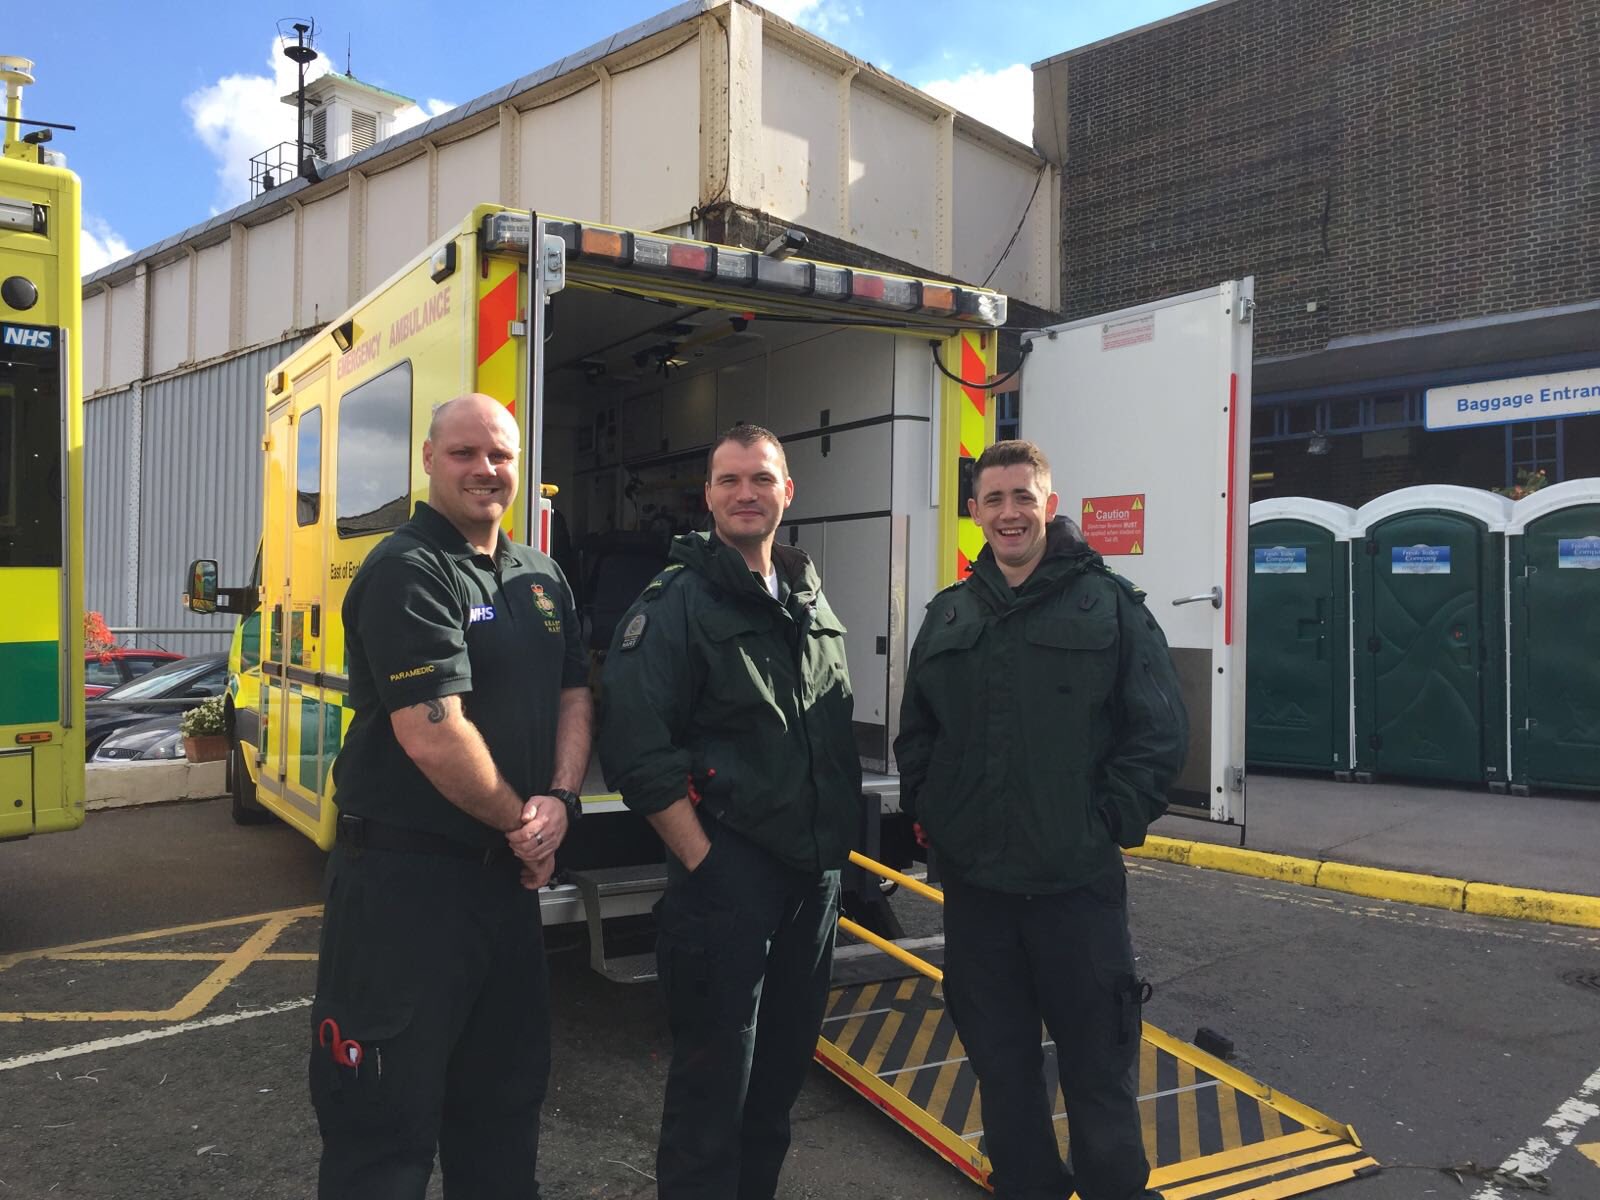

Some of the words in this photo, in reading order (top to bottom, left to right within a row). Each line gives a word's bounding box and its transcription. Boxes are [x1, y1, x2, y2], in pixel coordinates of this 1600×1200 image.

[4, 327, 52, 348] NHS
[337, 331, 382, 380] EMERGENCY
[389, 286, 451, 349] AMBULANCE
[1457, 393, 1534, 412] Baggage
[1540, 385, 1600, 402] Entran
[1095, 509, 1130, 521] Caution
[331, 563, 341, 579] East
[342, 561, 348, 579] of
[470, 606, 495, 622] NHS
[390, 665, 435, 681] PARAMEDIC
